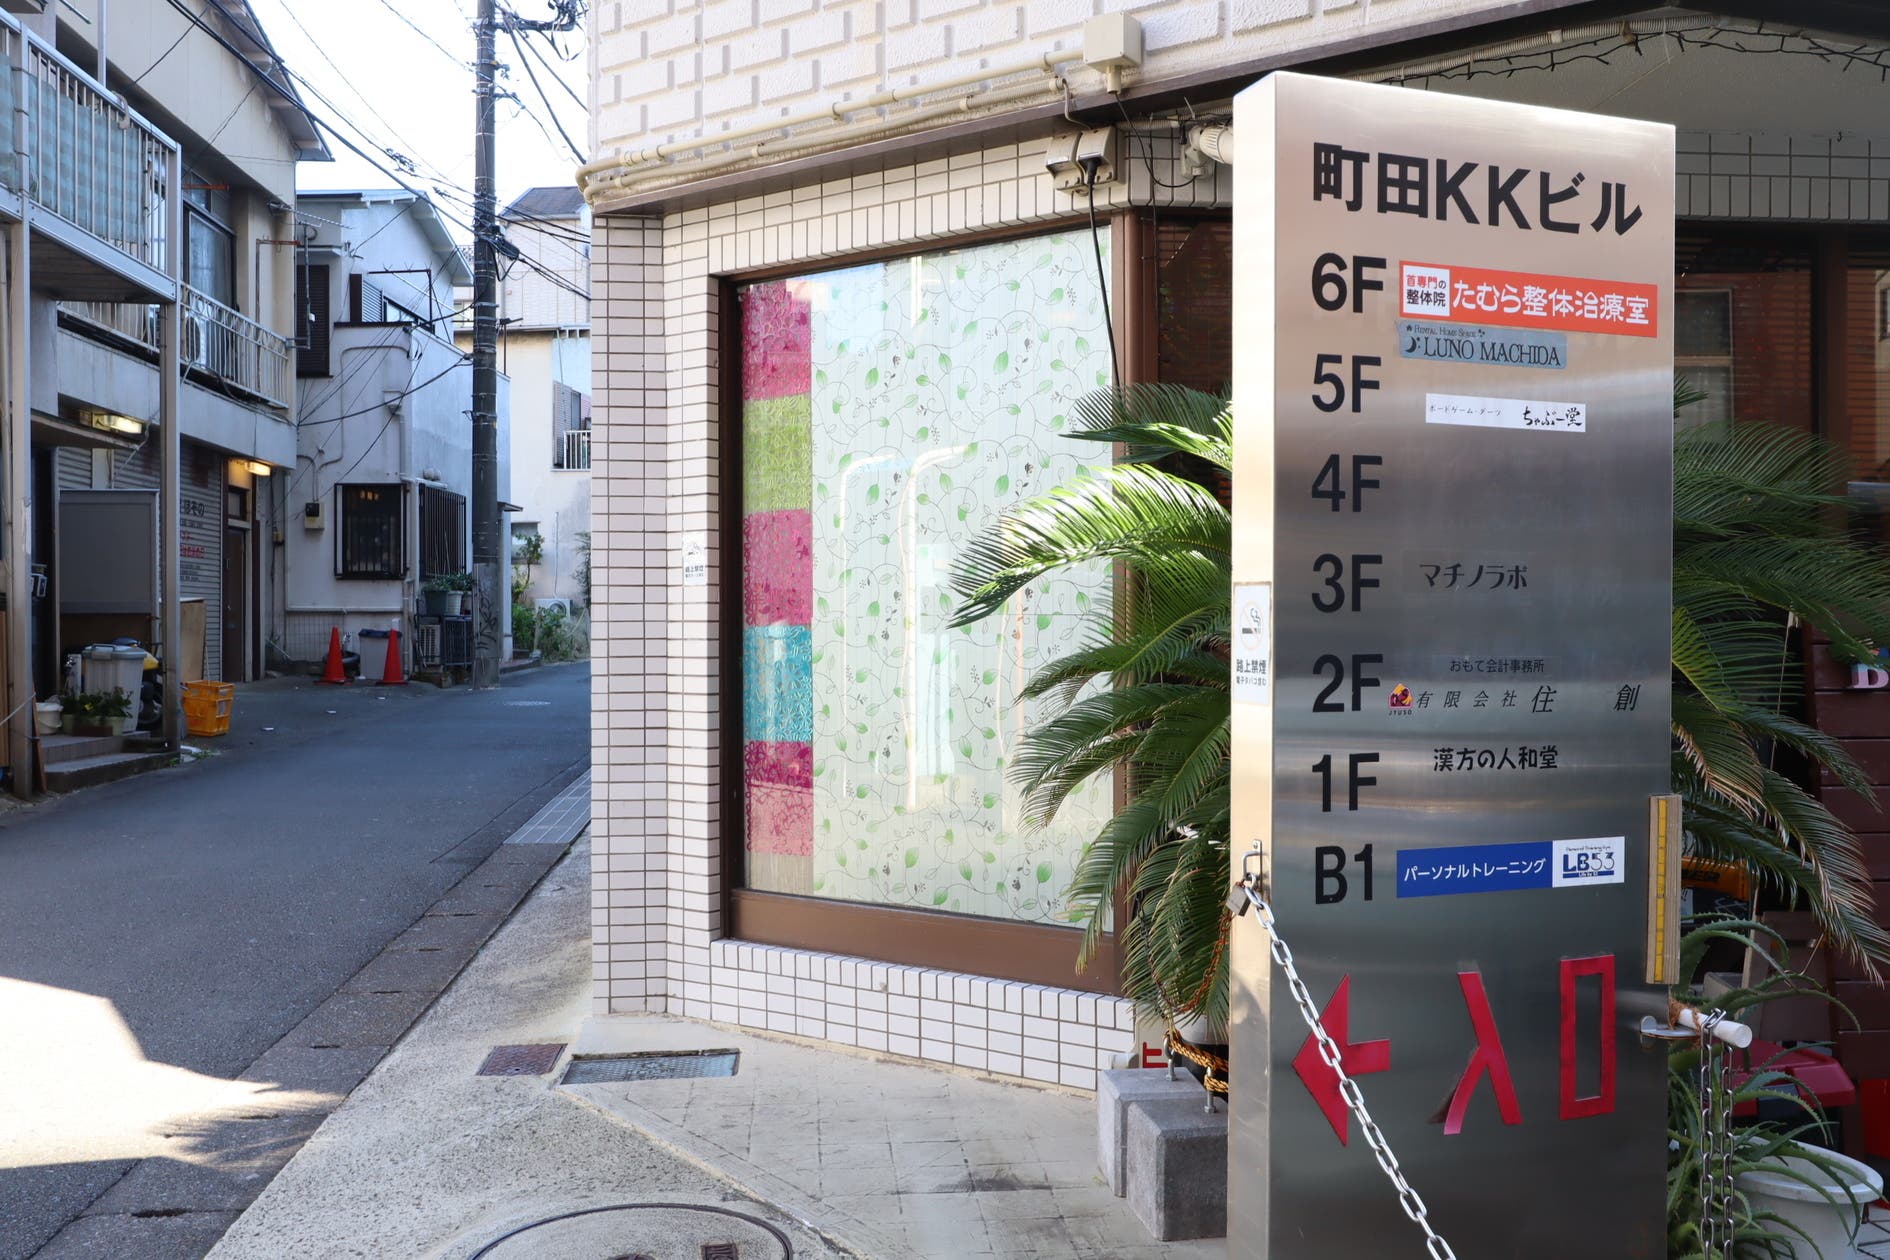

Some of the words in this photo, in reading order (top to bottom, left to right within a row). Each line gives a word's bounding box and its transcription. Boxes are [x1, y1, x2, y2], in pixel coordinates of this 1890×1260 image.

[1313, 142, 1643, 236] 町田KKビル
[1312, 252, 1386, 314] 6F
[1406, 274, 1446, 289] 首専門の
[1406, 289, 1446, 307] 整体院
[1453, 280, 1649, 325] たむら整体治療室
[1424, 337, 1474, 360] LUNO
[1480, 340, 1561, 367] MACHIDA
[1312, 353, 1382, 414] 5F
[1311, 454, 1383, 513] 4F
[1311, 553, 1383, 613] 3F
[1419, 563, 1528, 590] マチノラボ
[1312, 654, 1383, 713] 2F
[1450, 660, 1545, 674] おもて会計事務所
[1433, 745, 1559, 772] 漢方の人和堂
[1312, 752, 1380, 813] 1F
[1315, 843, 1373, 905] B1
[1404, 857, 1546, 882] パーソナルトレーニング
[1563, 852, 1615, 872] LB53
